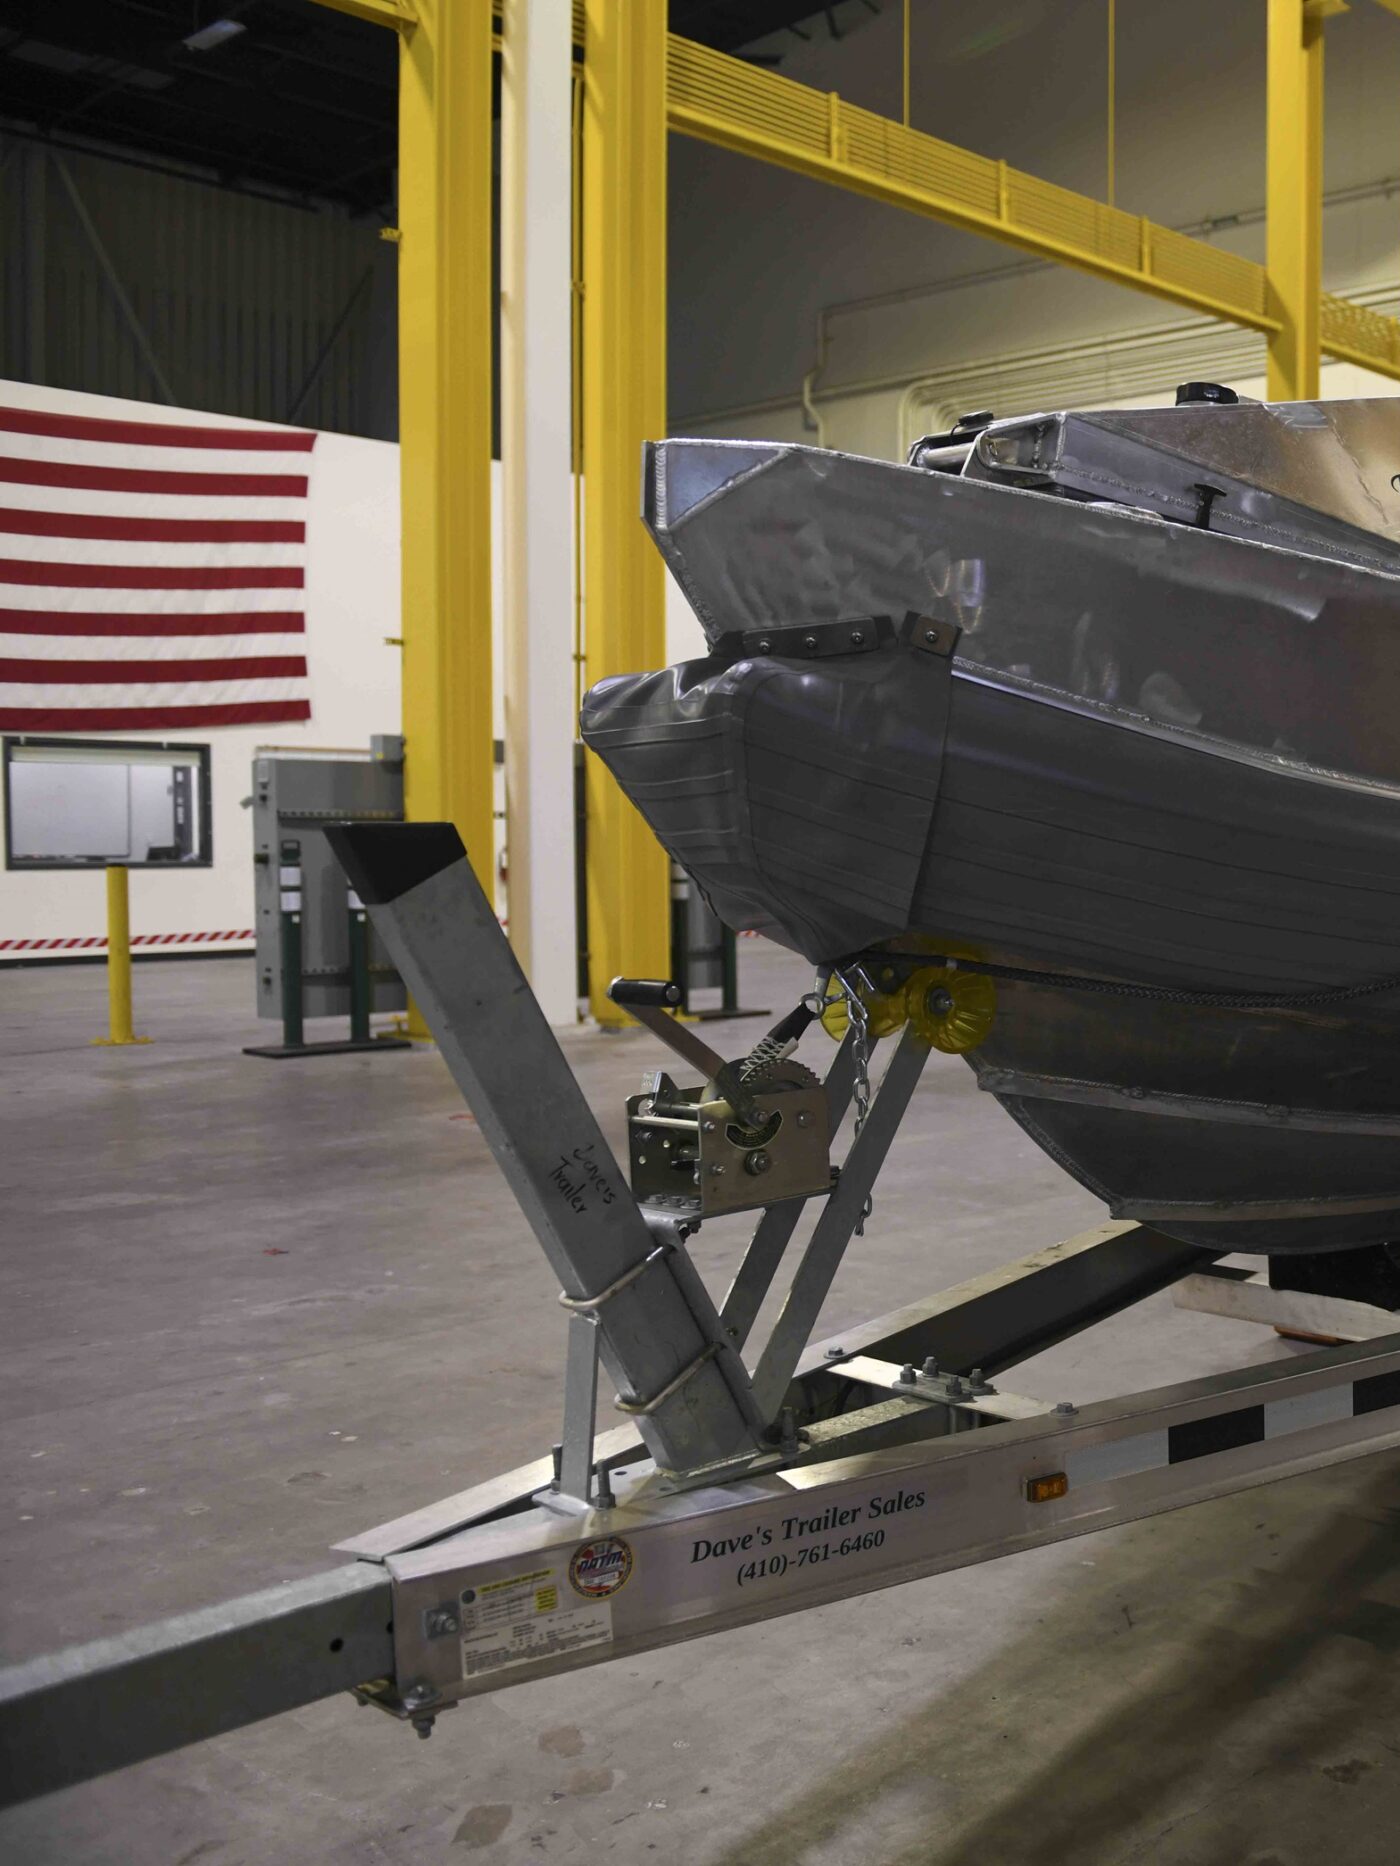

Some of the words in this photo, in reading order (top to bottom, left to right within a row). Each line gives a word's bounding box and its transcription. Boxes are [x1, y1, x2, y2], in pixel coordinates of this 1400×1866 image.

[547, 1154, 588, 1214] Trailer
[690, 1526, 773, 1564] Dave's
[781, 1505, 862, 1542] Trailer
[868, 1490, 926, 1519] Sales
[736, 1529, 885, 1587] (410)-761-6460
